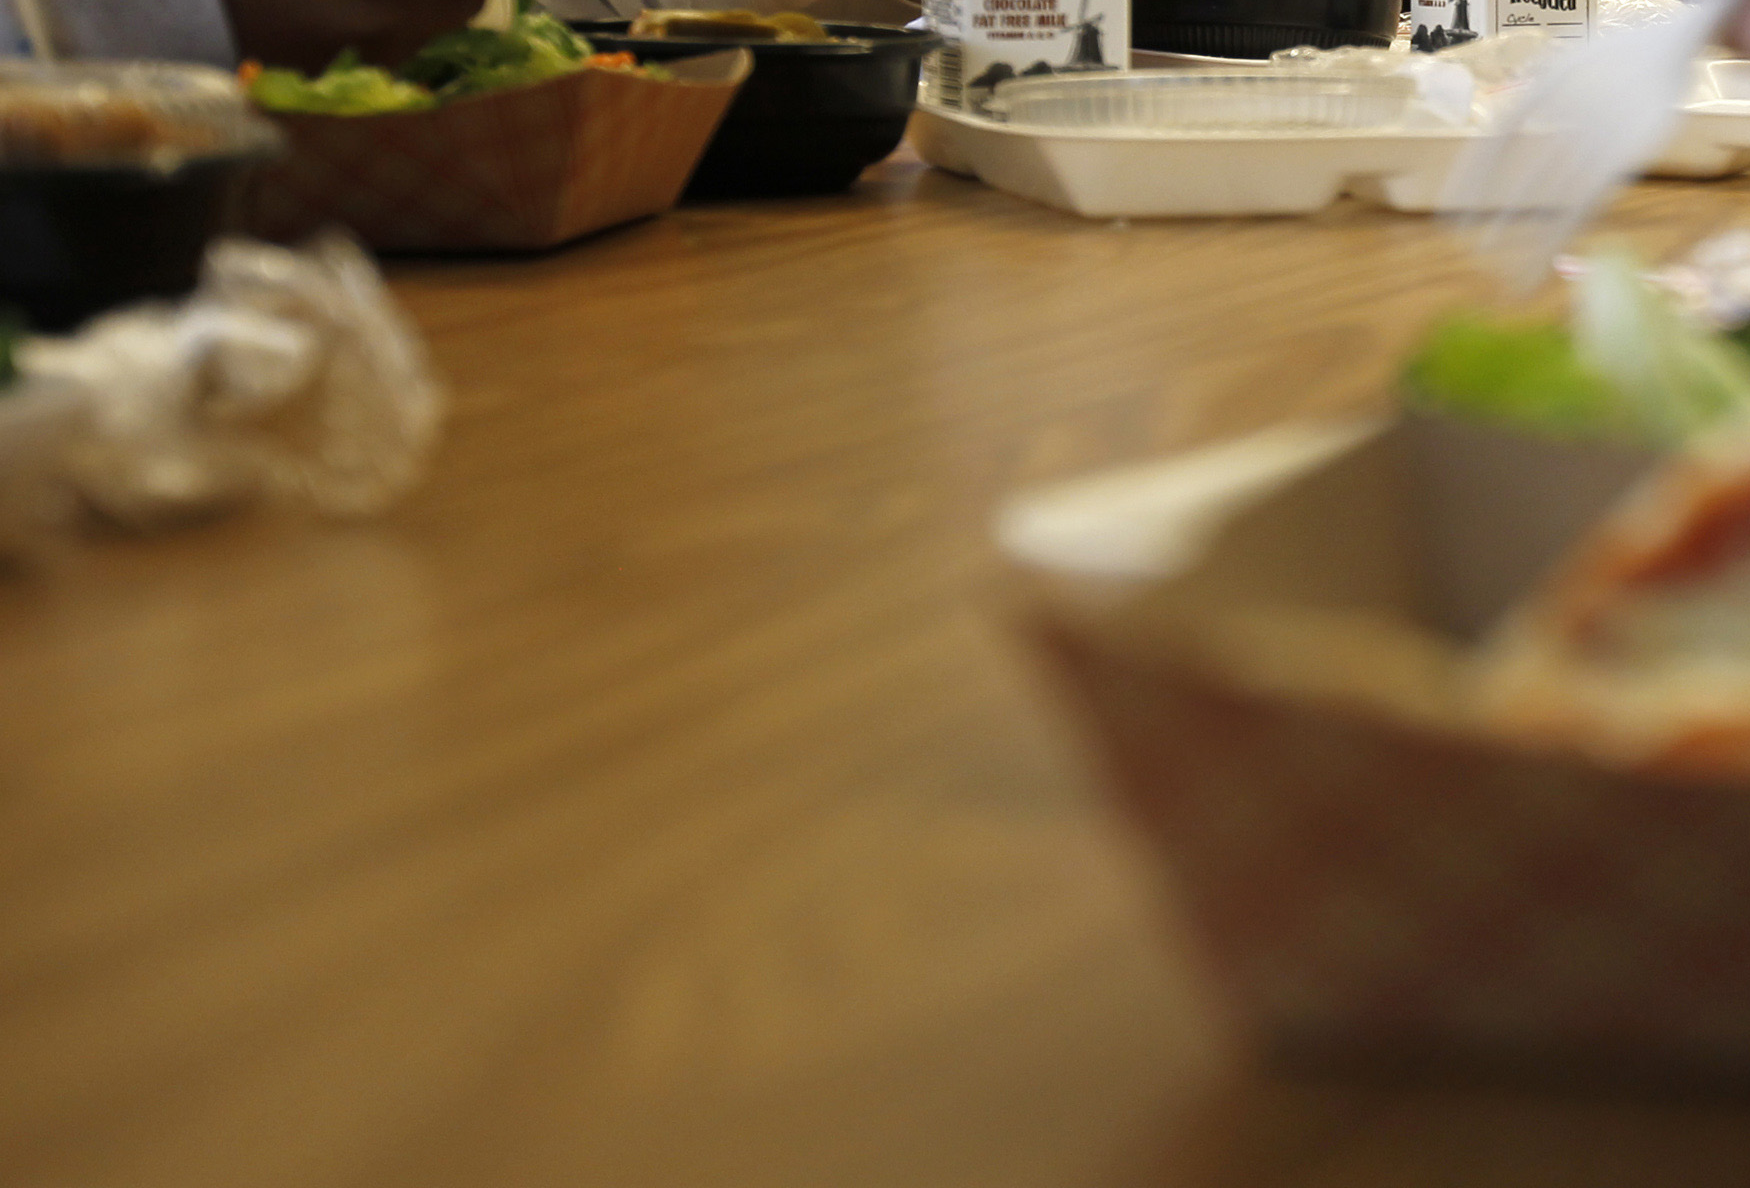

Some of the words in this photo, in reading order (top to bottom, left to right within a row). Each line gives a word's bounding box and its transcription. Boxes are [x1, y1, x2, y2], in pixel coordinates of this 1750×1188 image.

[972, 14, 997, 28] FAT
[1000, 14, 1031, 28] FREE
[1035, 14, 1066, 29] MILK
[1507, 13, 1534, 25] Cycle
[986, 30, 1024, 40] VITAMIN
